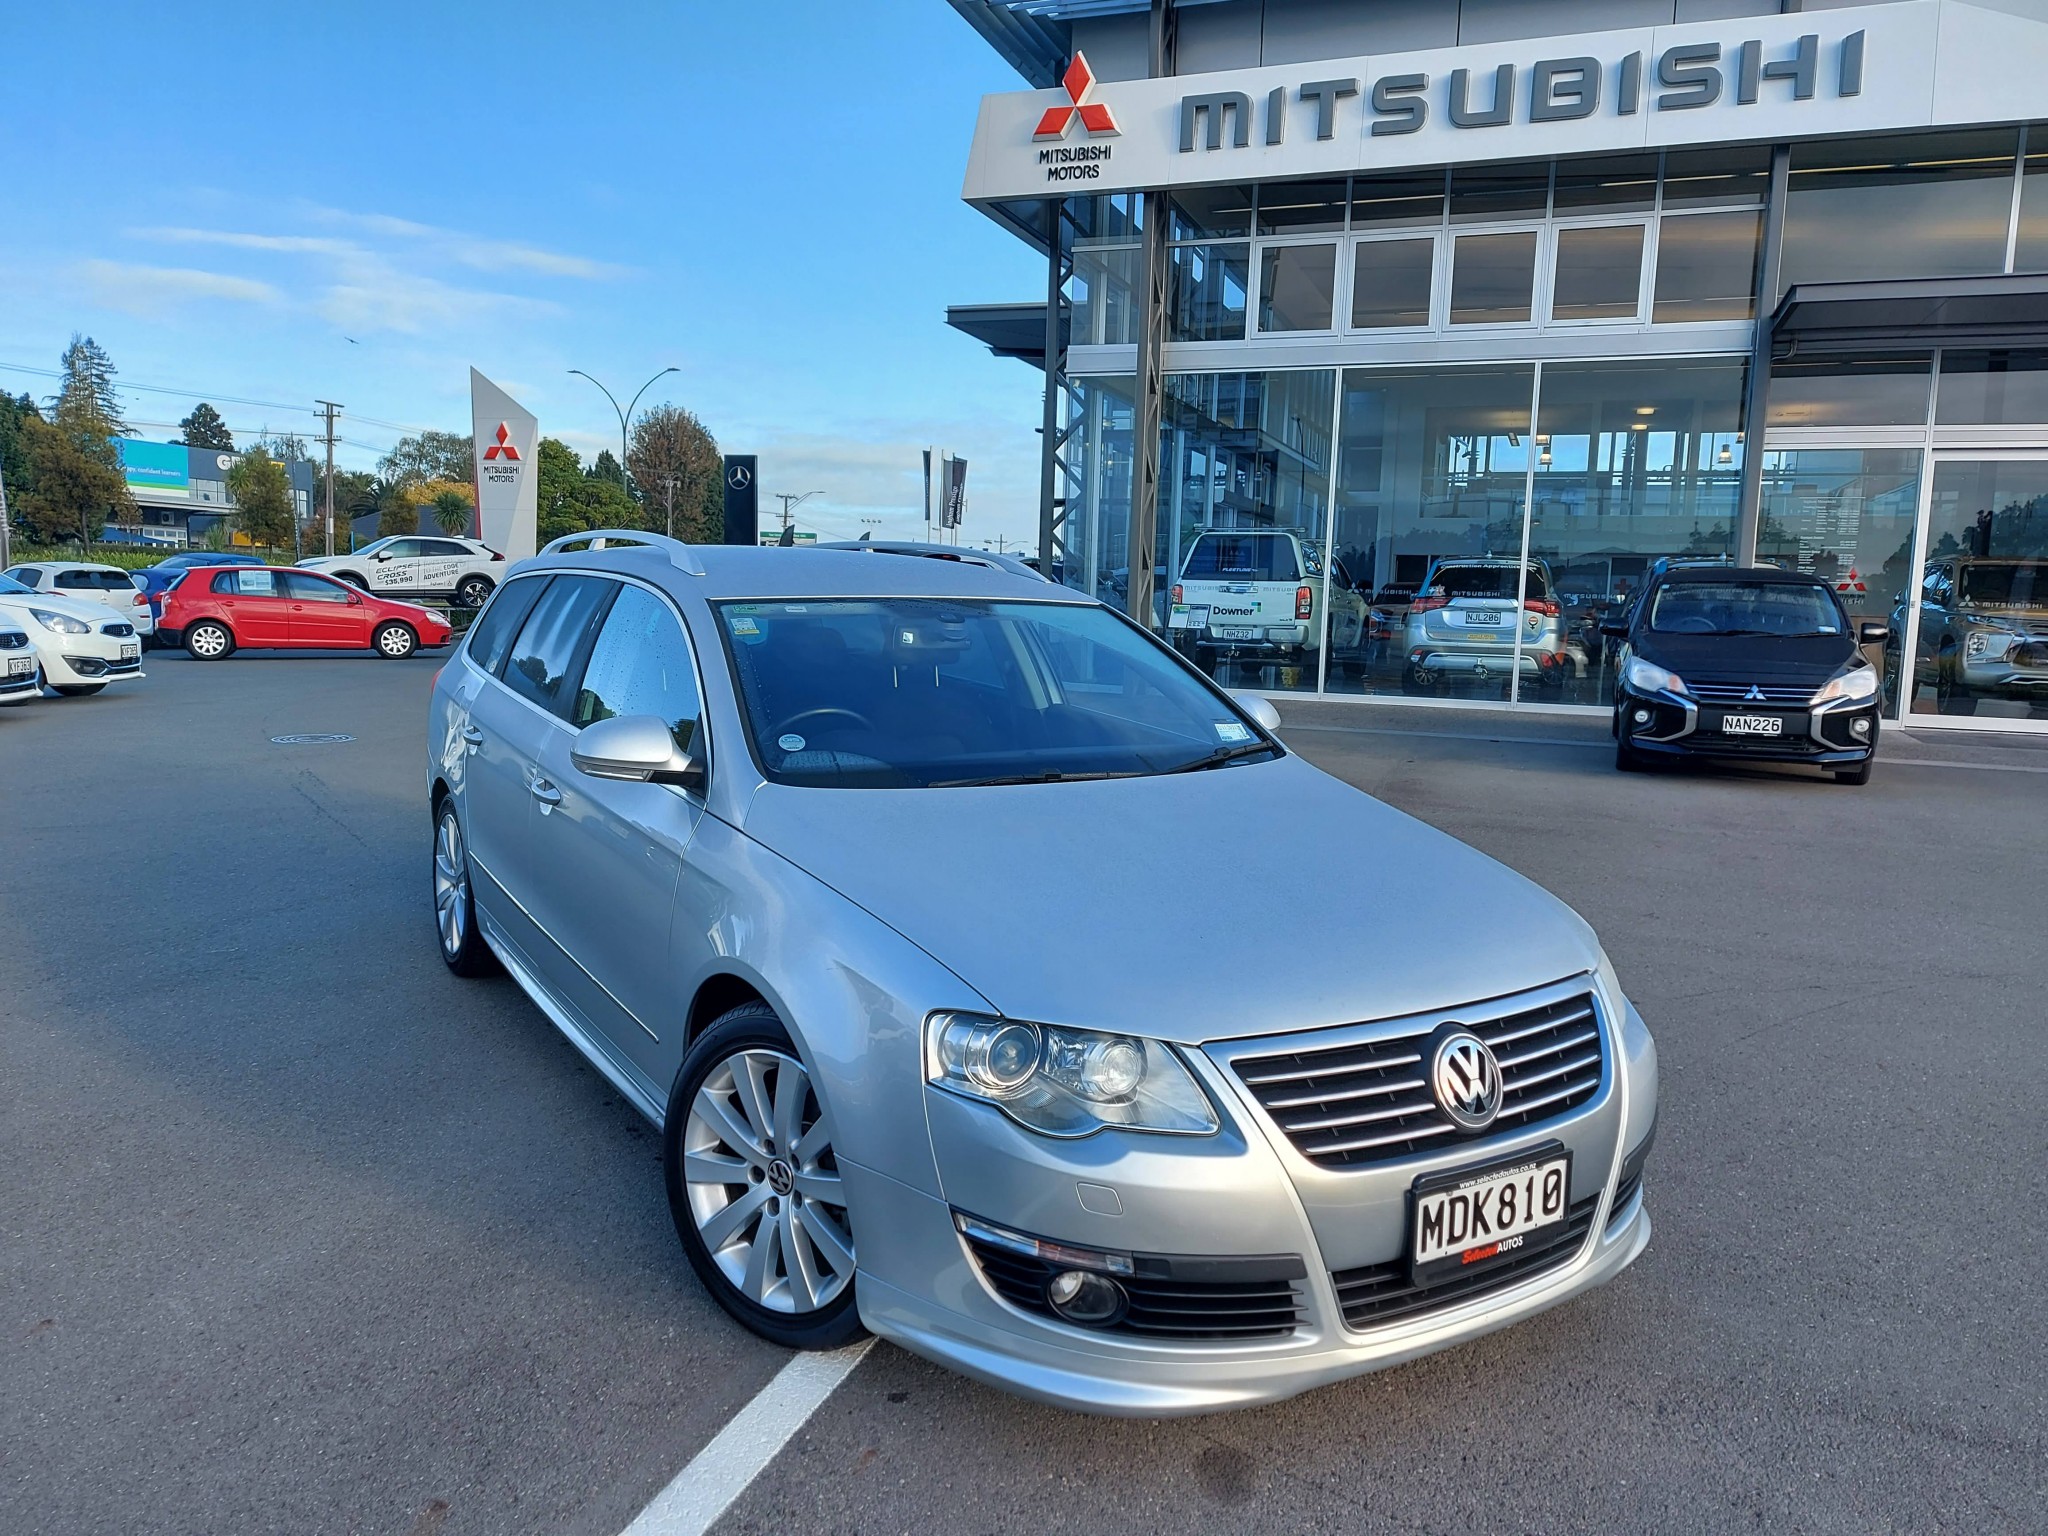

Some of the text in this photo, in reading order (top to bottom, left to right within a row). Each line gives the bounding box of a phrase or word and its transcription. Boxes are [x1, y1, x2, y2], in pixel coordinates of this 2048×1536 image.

[1179, 28, 1866, 154] MITSUBISHI
[1038, 144, 1112, 165] MITSUBISHI
[1047, 164, 1100, 182] MOTORS
[483, 465, 520, 474] MITSUBISHI
[488, 475, 515, 483] MOTORS
[376, 563, 413, 574] ECLIPSE
[377, 570, 408, 580] CROSS
[423, 569, 459, 581] ADVENTURE
[1213, 606, 1254, 616] Downer
[1982, 601, 2043, 609] MITSUBISHI
[1467, 613, 1499, 622] NJL206
[1226, 630, 1250, 639] NHZ32
[9, 660, 30, 673] KYF363
[1724, 716, 1780, 732] NAN226
[1459, 1162, 1537, 1190] www.selectedautos.co.nz
[1420, 1168, 1563, 1254] MDK810
[1496, 1235, 1524, 1254] AUTOS
